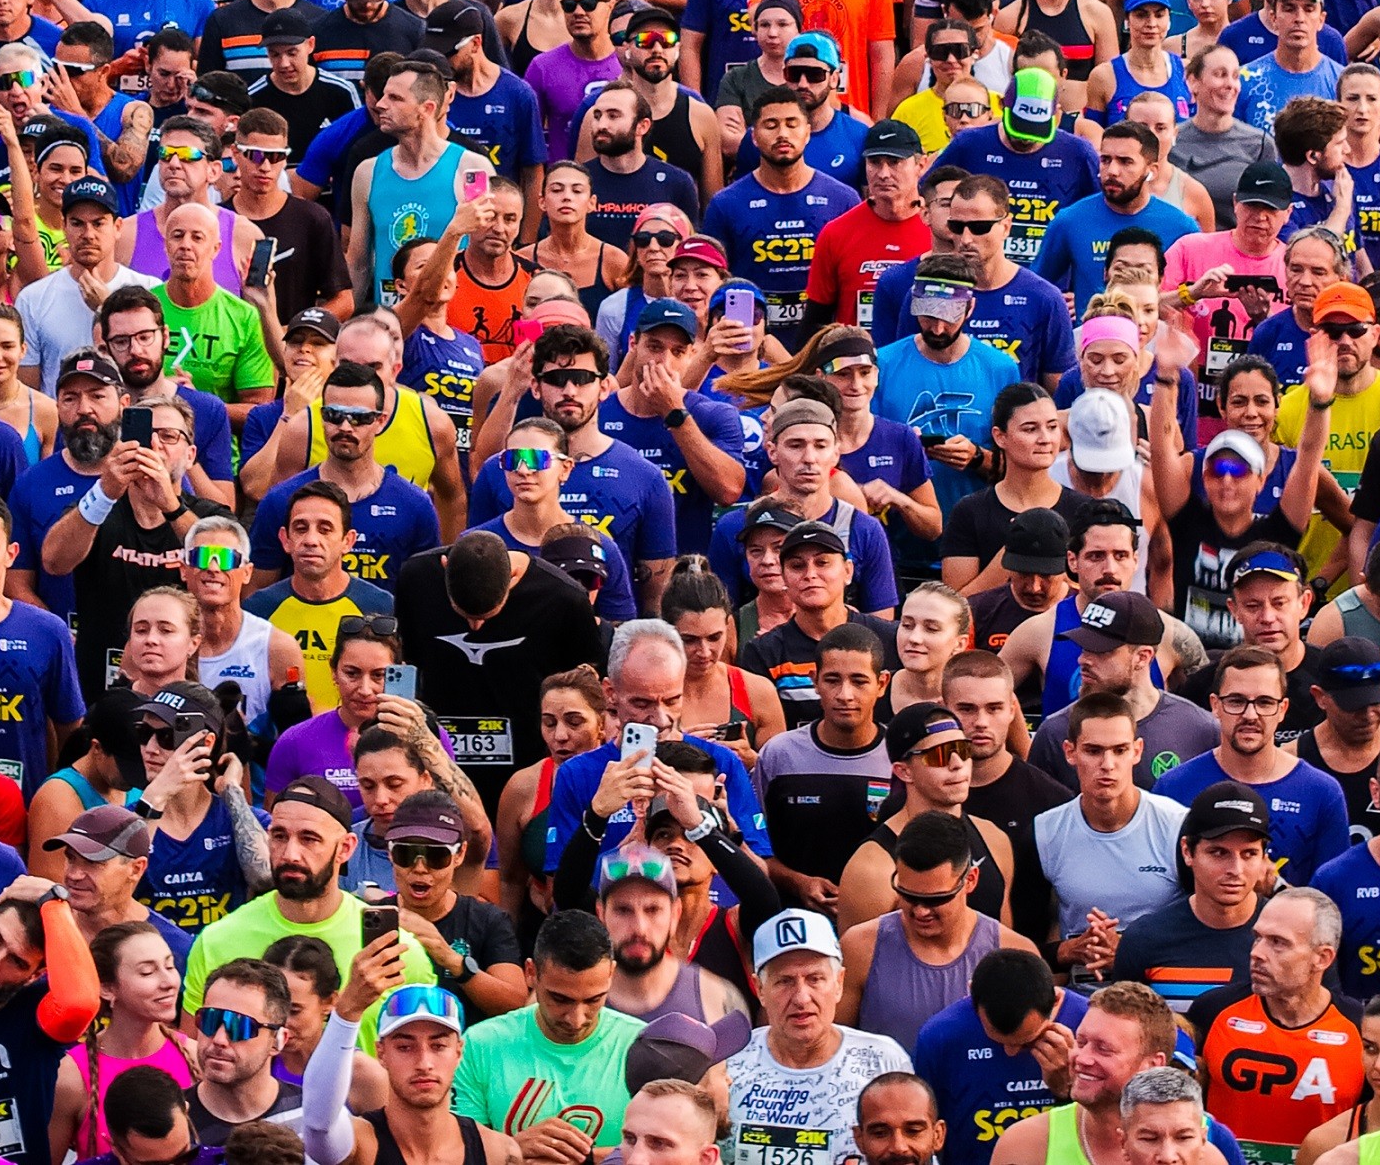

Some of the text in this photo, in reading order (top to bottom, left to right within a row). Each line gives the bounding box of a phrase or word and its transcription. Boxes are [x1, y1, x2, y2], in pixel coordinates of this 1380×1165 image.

[1019, 103, 1049, 117] RUN
[1009, 180, 1037, 188] CAIXA
[775, 220, 804, 228] CAIXA
[752, 240, 814, 262] SC21
[779, 305, 803, 320] 201
[970, 320, 999, 328] CAIXA
[1325, 430, 1373, 450] RASI
[154, 692, 184, 708] LIVE!
[478, 720, 503, 731] 21K
[1139, 865, 1166, 873] adidas
[164, 872, 203, 885] CAIXA
[1357, 888, 1380, 899] RVB
[968, 1048, 992, 1060] RVB
[1222, 1049, 1338, 1104] GPA
[1007, 1080, 1048, 1091] CAIXA
[751, 1084, 809, 1104] Running
[739, 1093, 795, 1110] Around
[795, 1131, 826, 1144] 21K
[757, 1147, 813, 1165] 1526
